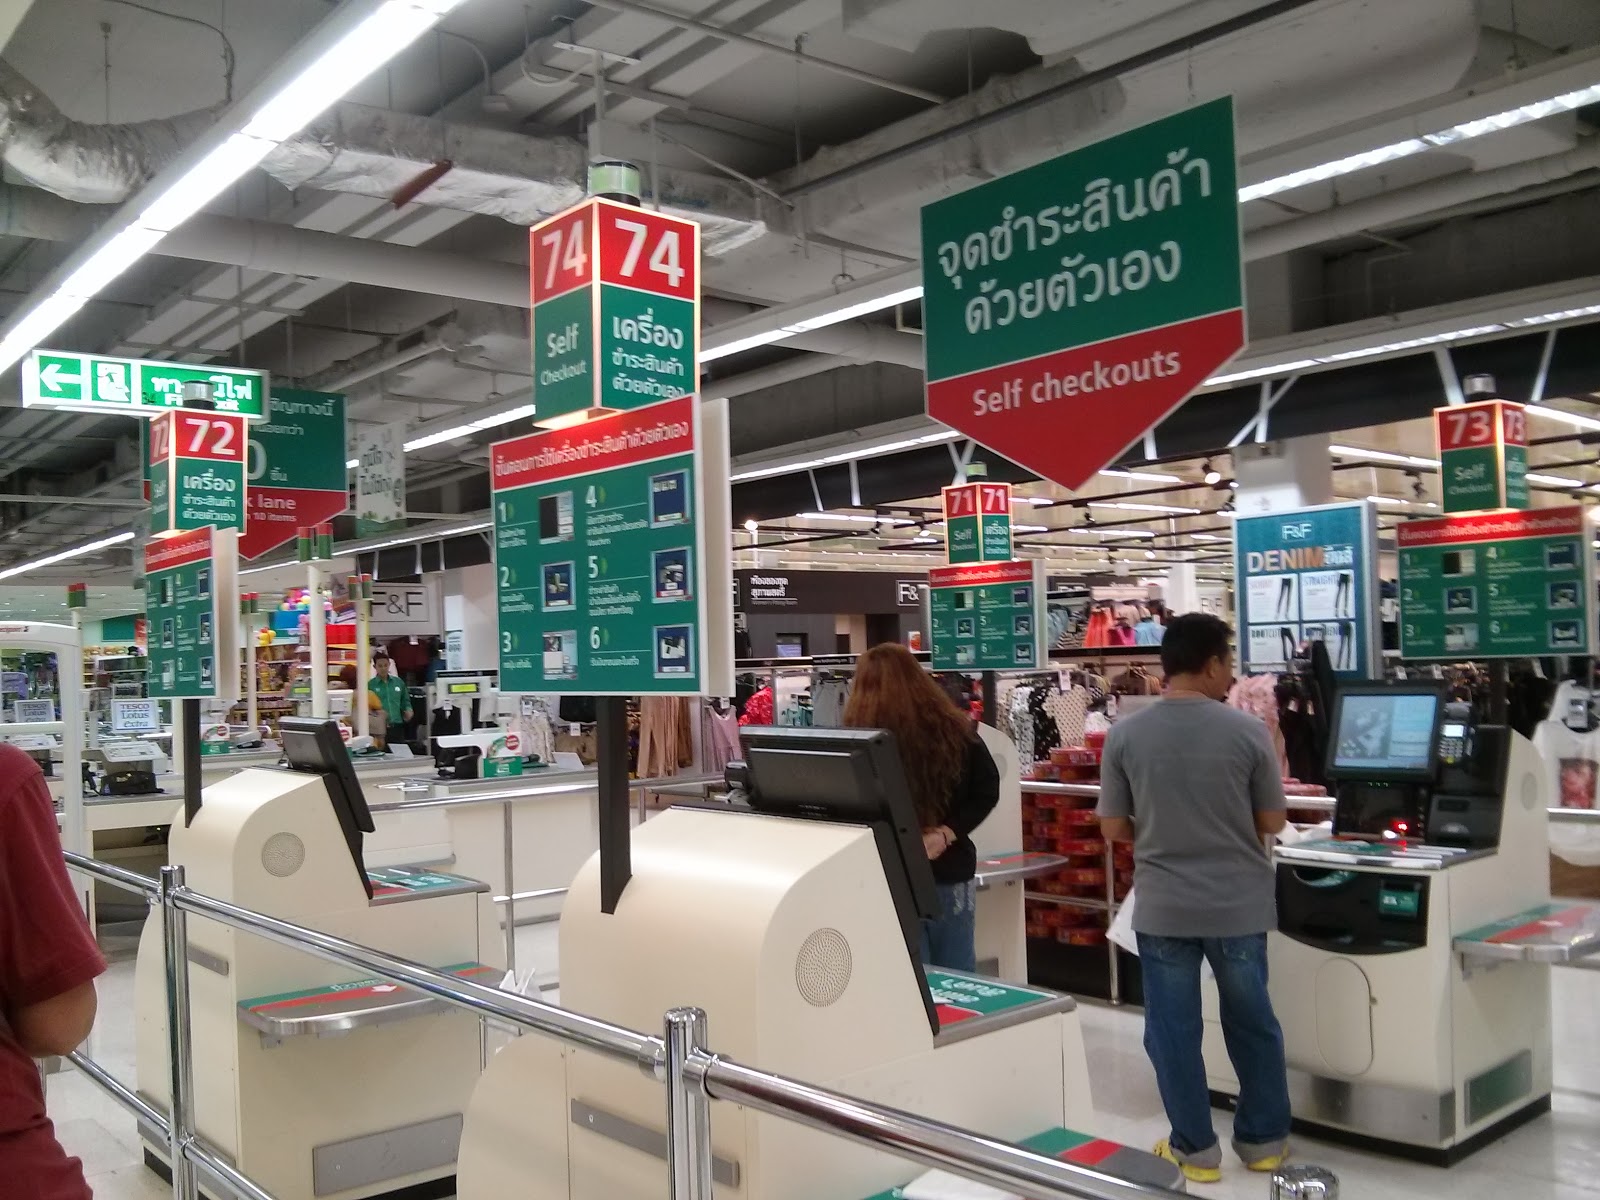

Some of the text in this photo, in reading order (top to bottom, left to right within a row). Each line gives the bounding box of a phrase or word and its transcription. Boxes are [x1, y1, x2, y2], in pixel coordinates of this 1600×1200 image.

[937, 147, 1212, 290] จุดชำระสินค้า
[541, 219, 588, 290] 74
[614, 217, 686, 288] 74
[964, 239, 1182, 335] ด้วยตัวเอง
[547, 322, 580, 358] Self
[612, 307, 684, 350] เครื่อง
[612, 346, 685, 377] ชำระสินค้า
[972, 349, 1182, 417] Self checkouts
[185, 418, 235, 456] 72
[1447, 411, 1491, 444] 73
[183, 468, 236, 492] เครื่อง
[1454, 463, 1486, 481] Self
[258, 493, 297, 510] lane
[586, 485, 597, 508] 4
[949, 491, 974, 514] 71
[982, 488, 1006, 511] 71
[498, 502, 507, 523] 1
[1282, 523, 1312, 540] F&F
[588, 555, 599, 579] 5
[1246, 546, 1325, 573] DENIM
[500, 566, 511, 588] 2
[370, 591, 423, 615] F&F
[502, 631, 512, 653] 3
[590, 626, 601, 650] 6
[122, 712, 149, 720] Lotus
